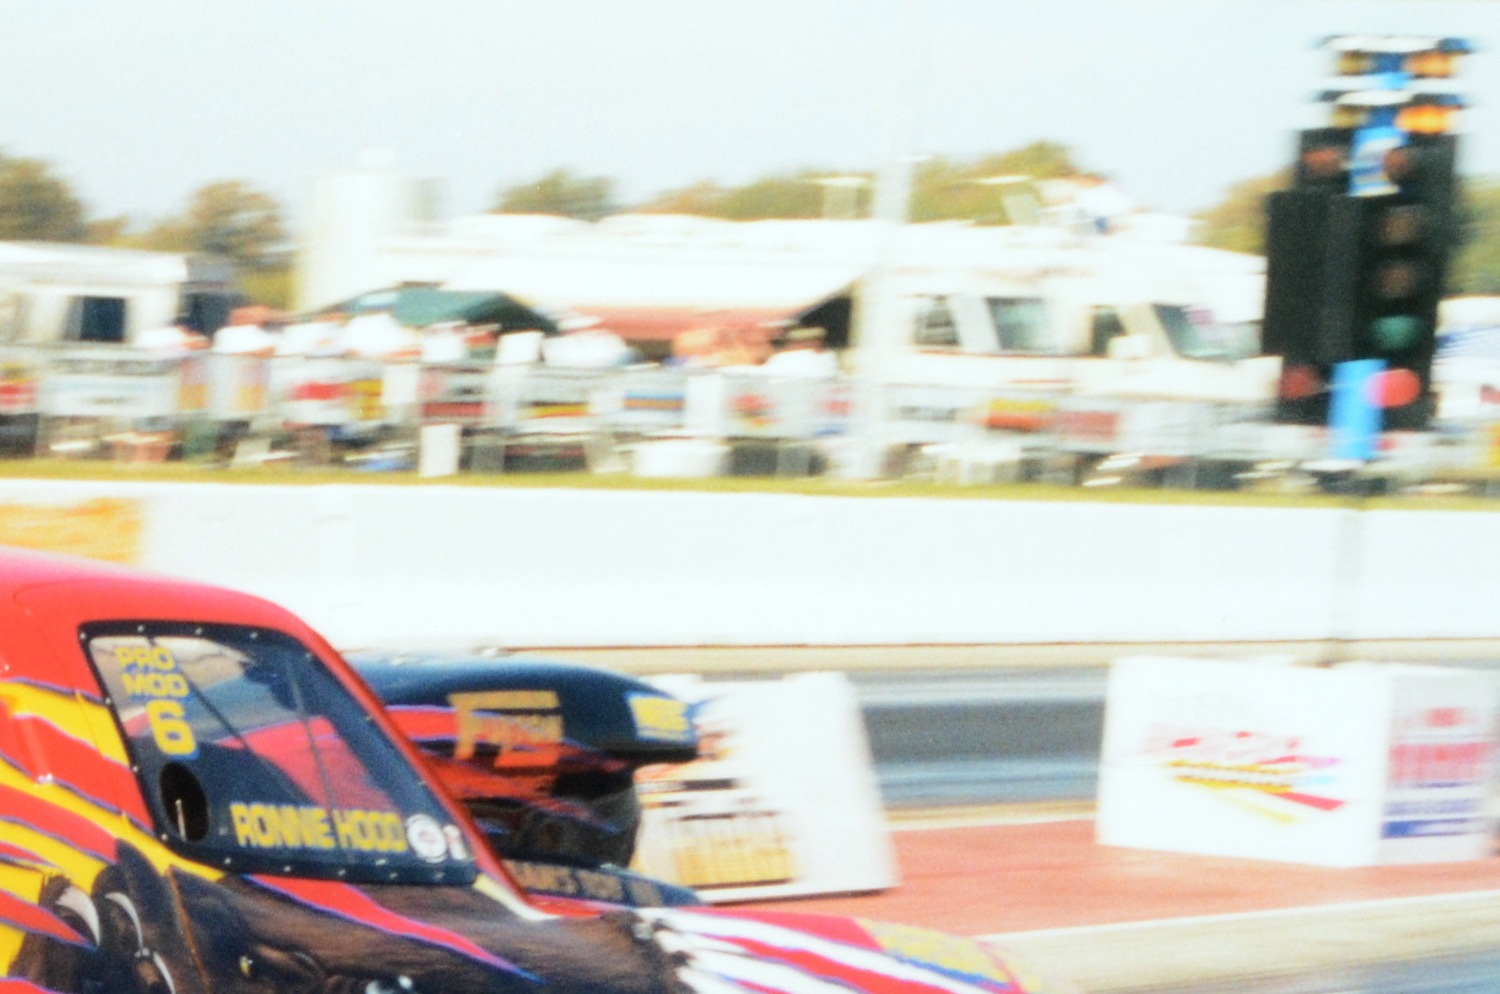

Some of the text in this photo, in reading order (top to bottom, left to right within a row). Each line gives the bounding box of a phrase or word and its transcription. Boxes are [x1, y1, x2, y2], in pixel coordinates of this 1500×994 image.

[115, 646, 176, 671] PRO
[121, 673, 190, 697] MOD
[146, 700, 197, 756] 6
[230, 803, 335, 848] RONNIE
